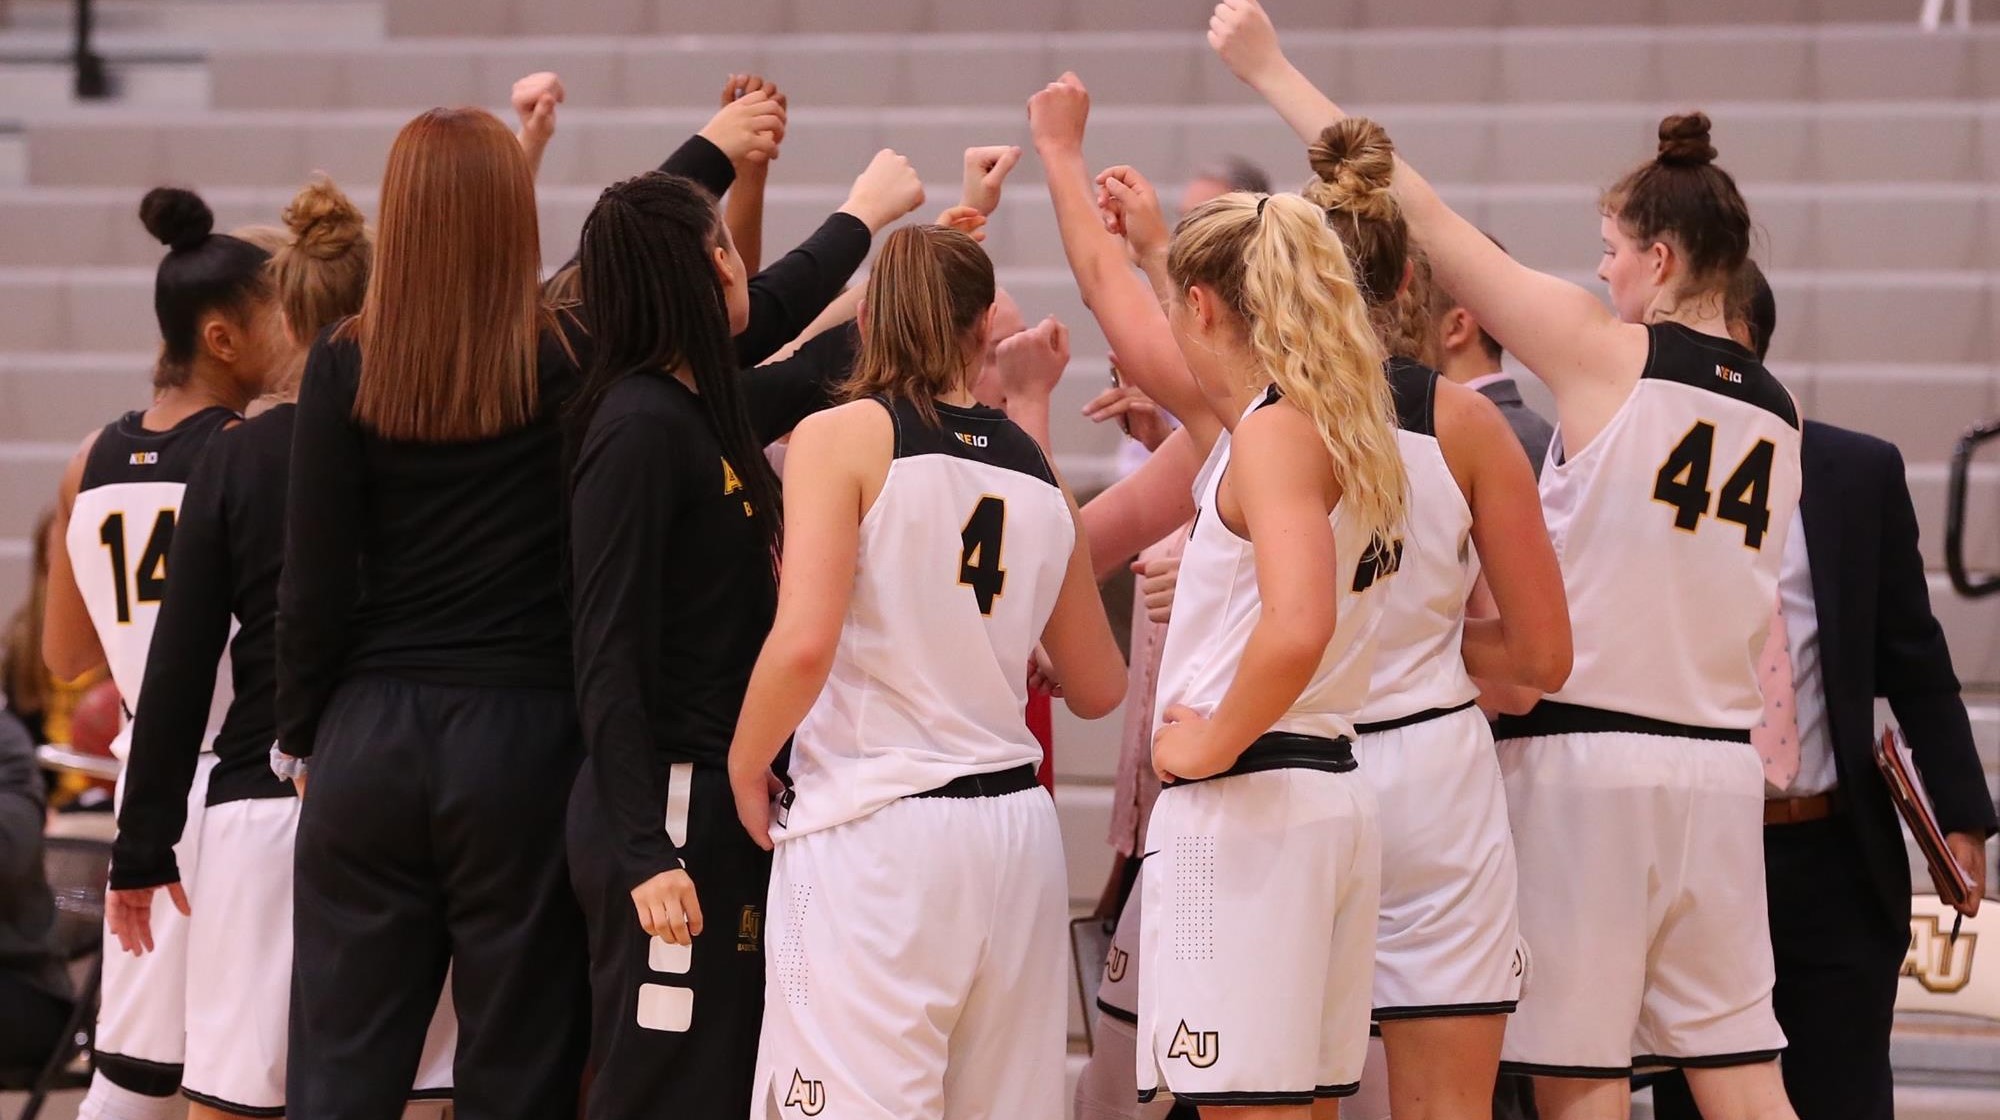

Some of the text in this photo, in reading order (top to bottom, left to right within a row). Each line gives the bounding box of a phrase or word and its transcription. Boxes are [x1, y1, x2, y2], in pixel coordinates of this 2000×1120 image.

[720, 456, 744, 495] A
[1651, 419, 1777, 552] 44
[99, 507, 177, 625] 14
[957, 493, 1008, 619] 4
[1104, 945, 1129, 983] U
[1898, 915, 1977, 994] AU
[1167, 1018, 1219, 1069] AU
[784, 1067, 826, 1117] AU
